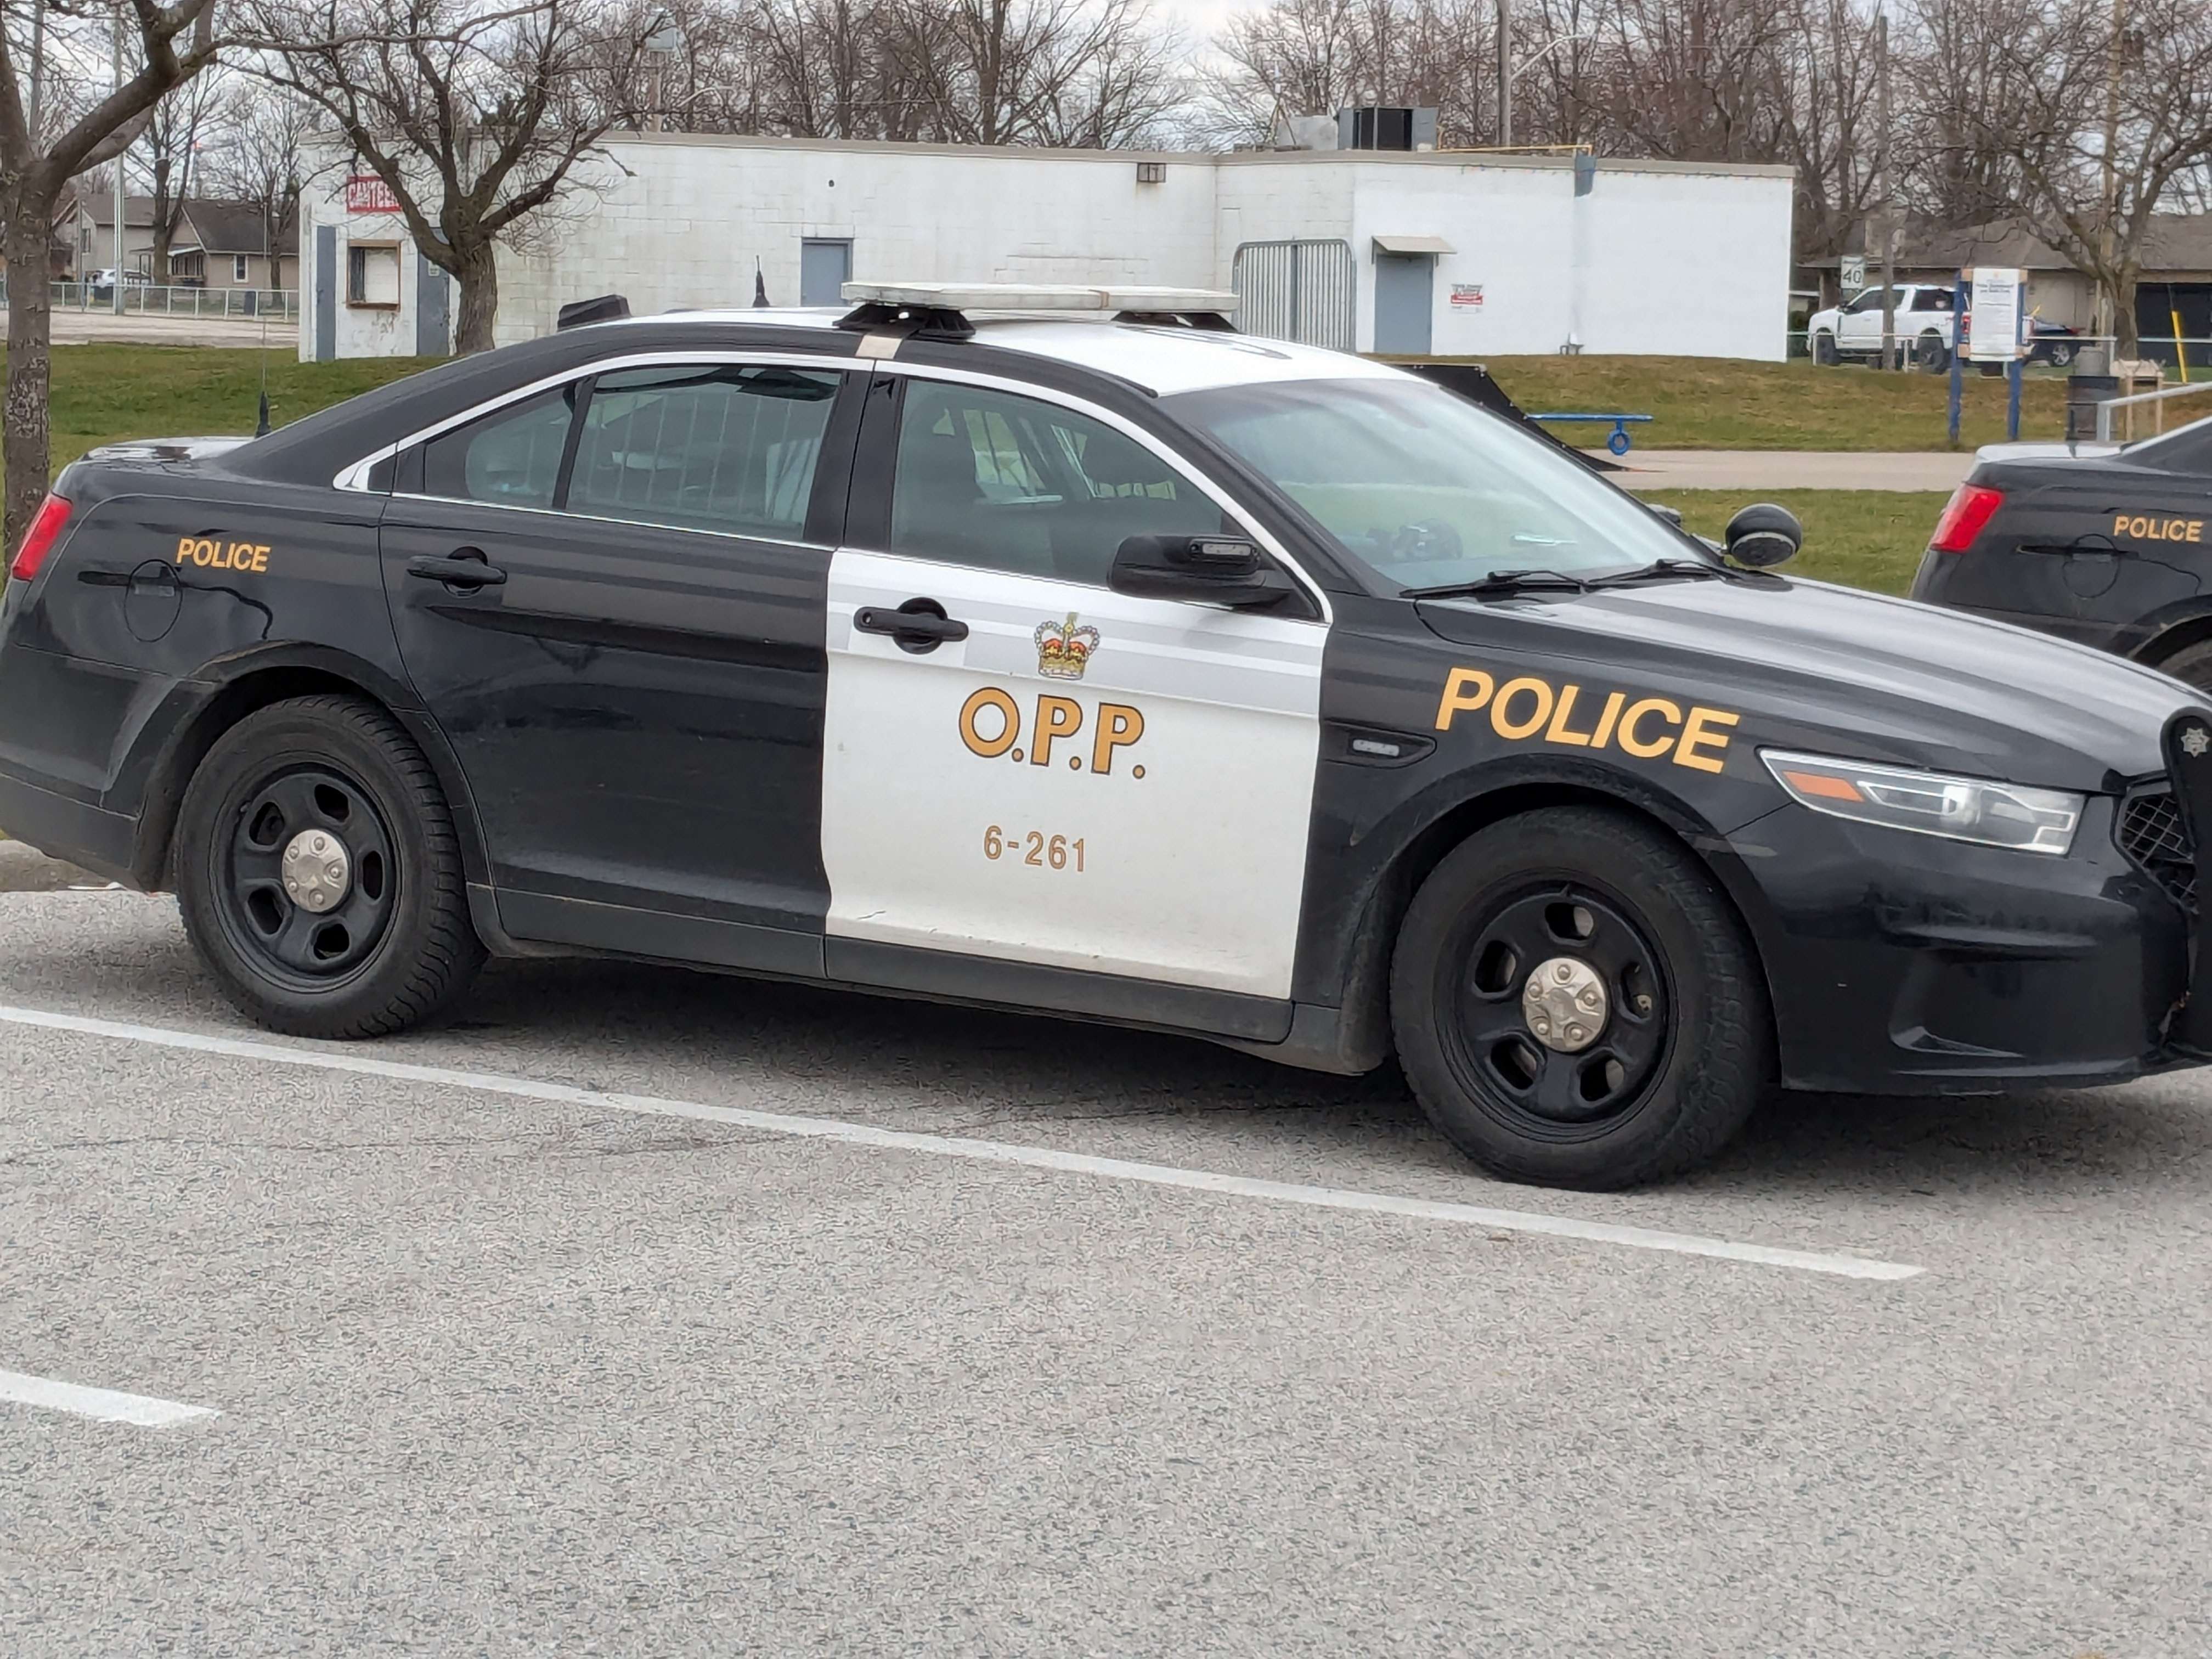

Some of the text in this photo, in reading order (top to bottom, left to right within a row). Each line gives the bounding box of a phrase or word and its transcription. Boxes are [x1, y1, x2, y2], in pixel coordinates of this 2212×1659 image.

[348, 180, 399, 208] CANTEE
[1843, 269, 1862, 284] 40
[2113, 515, 2204, 543] POLICE
[176, 538, 271, 572] POLICE
[958, 686, 1146, 780] O.P.P.
[1434, 667, 1740, 774] POLICE
[983, 825, 1085, 872] 6-261
